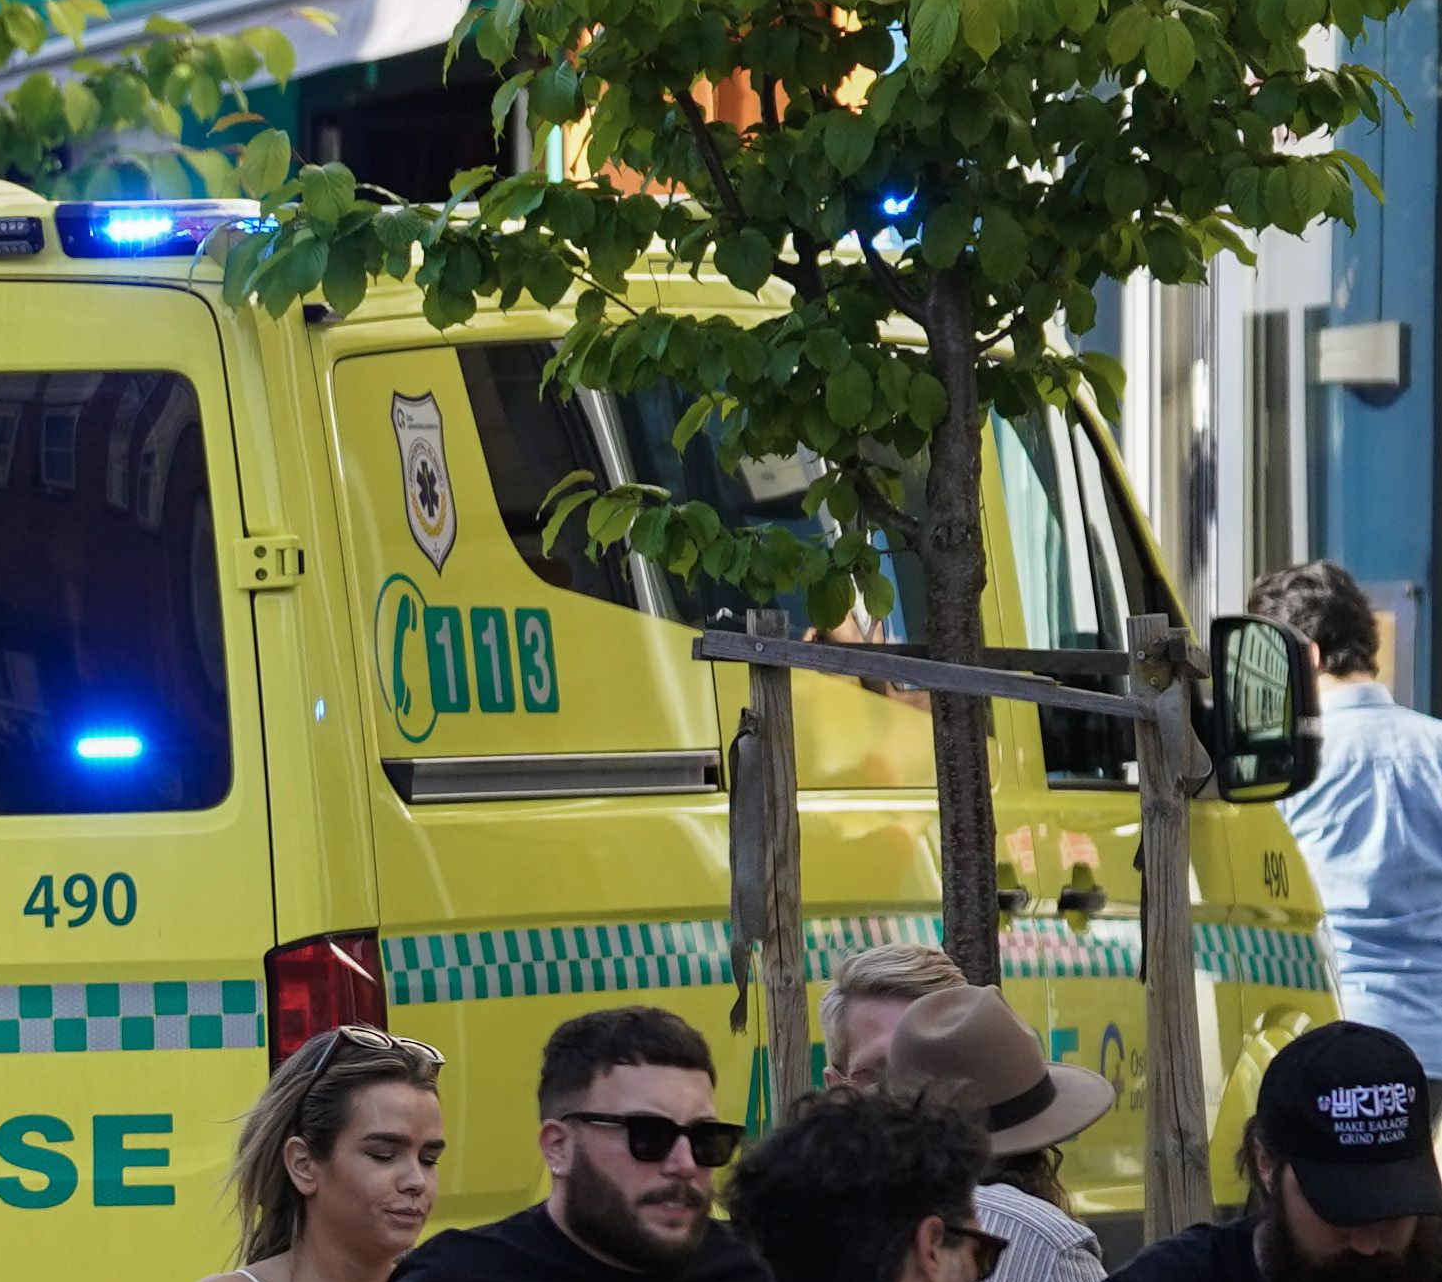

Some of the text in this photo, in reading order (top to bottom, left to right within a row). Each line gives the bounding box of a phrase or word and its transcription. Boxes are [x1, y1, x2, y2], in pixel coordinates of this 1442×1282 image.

[434, 615, 552, 705] 113
[1264, 849, 1290, 898] 490
[23, 873, 138, 929] 490
[1334, 1120, 1365, 1132] MAKE
[1339, 1130, 1406, 1145] GRIND AGAIN
